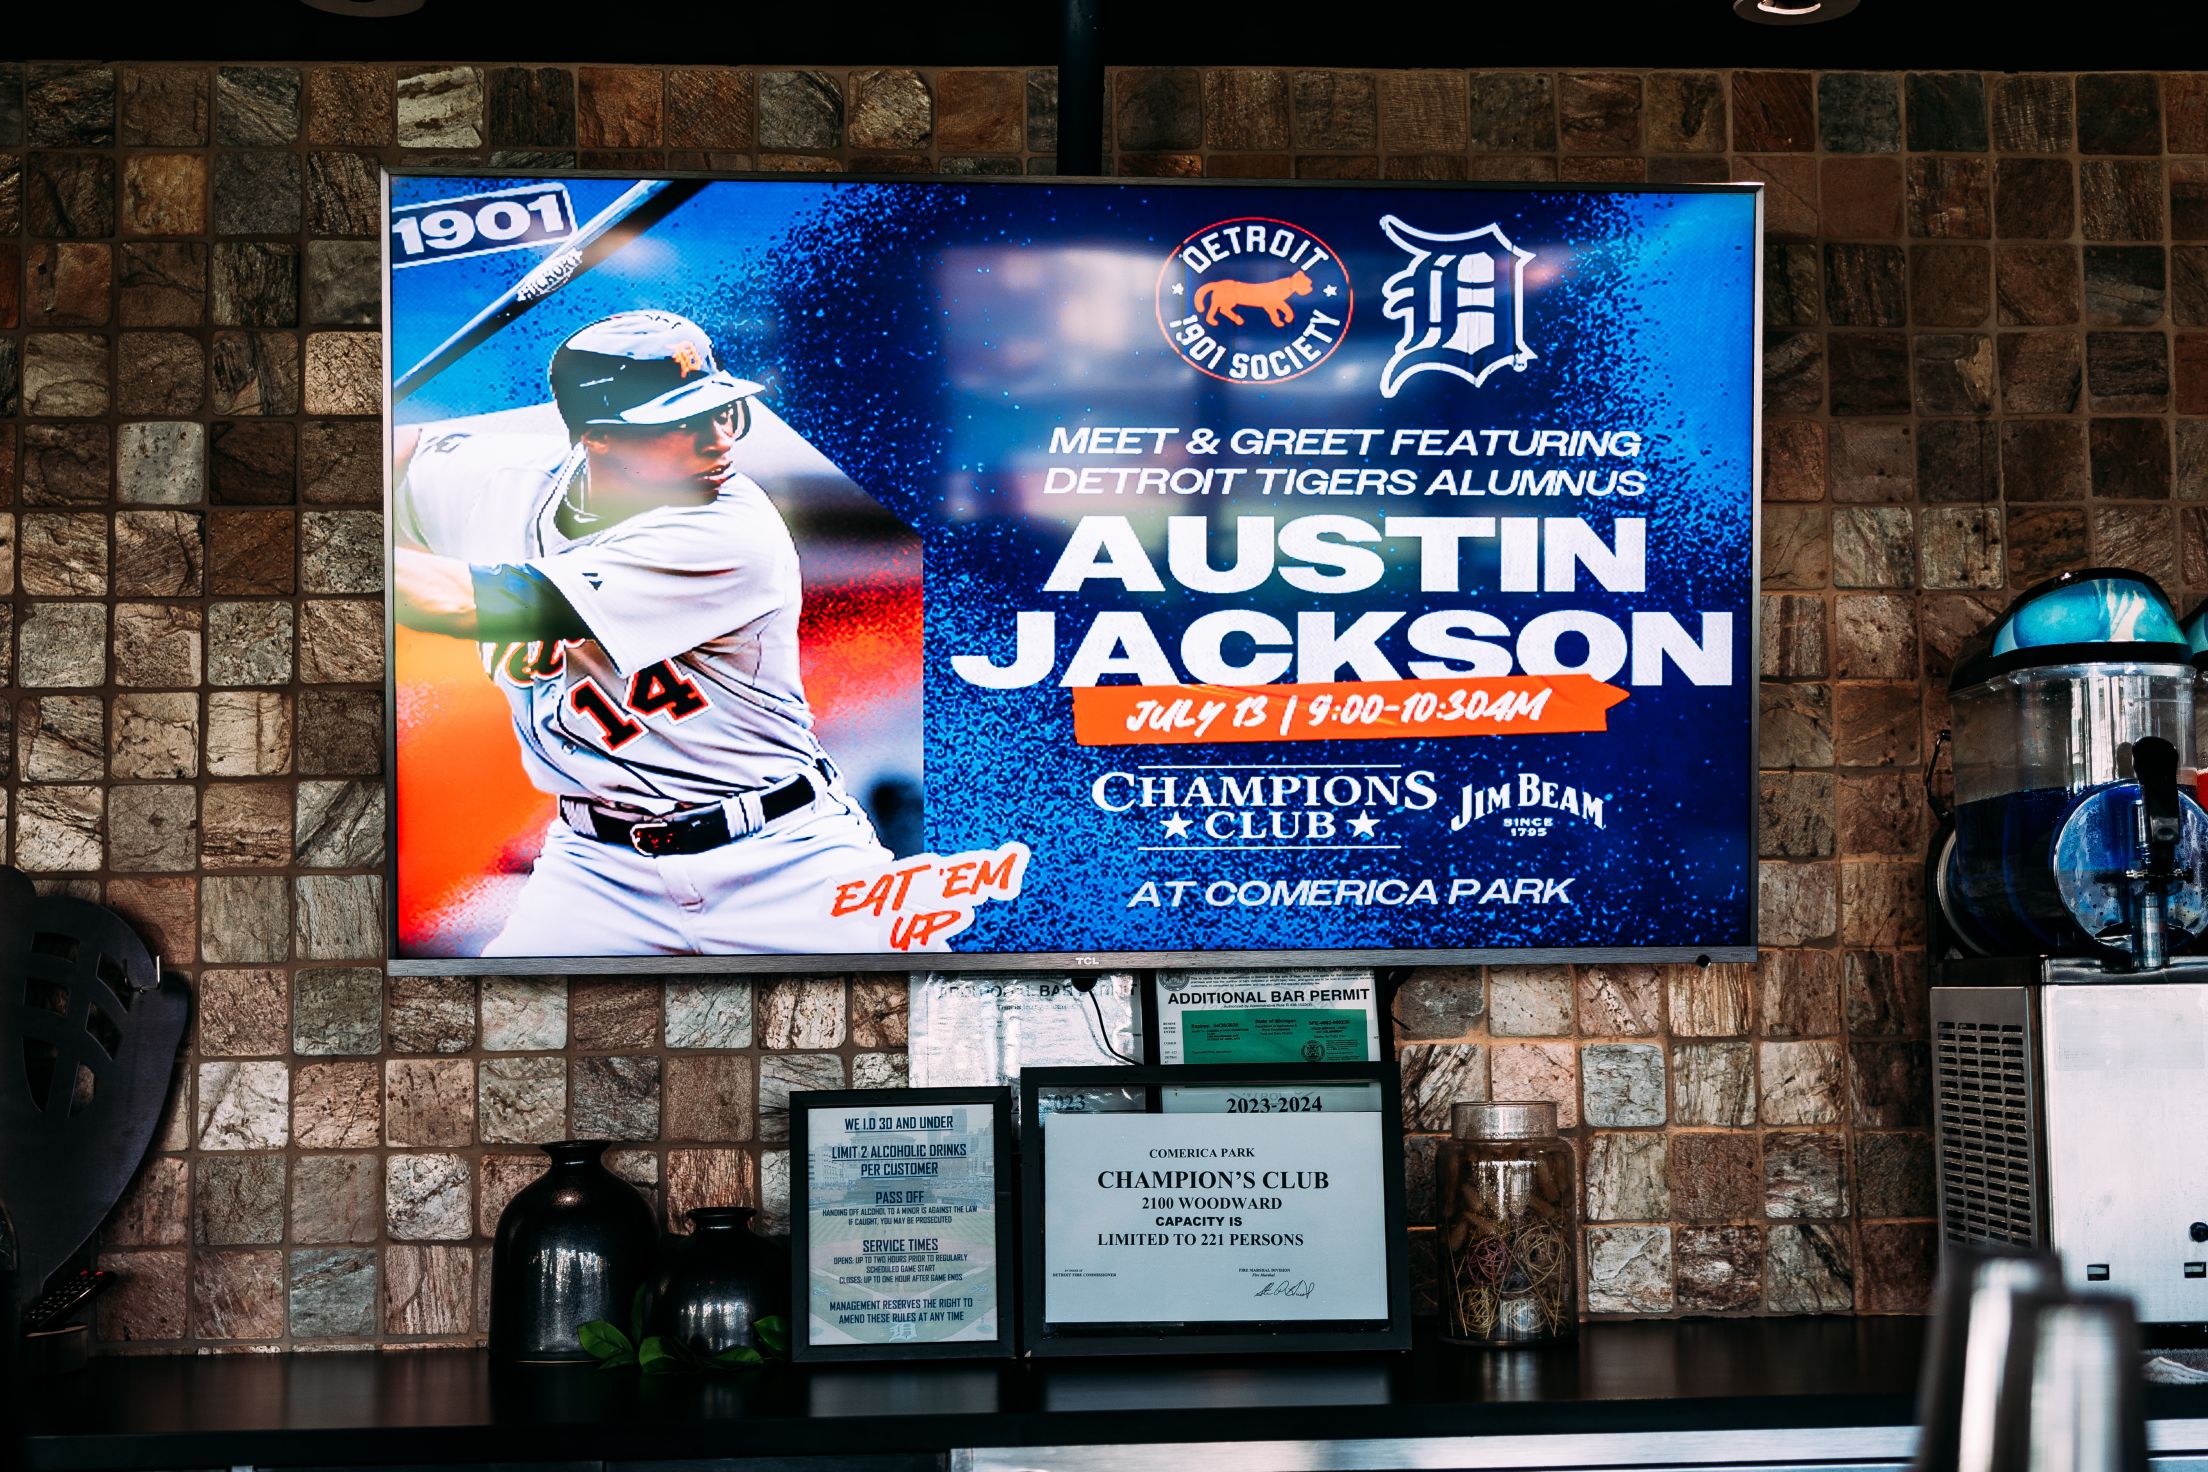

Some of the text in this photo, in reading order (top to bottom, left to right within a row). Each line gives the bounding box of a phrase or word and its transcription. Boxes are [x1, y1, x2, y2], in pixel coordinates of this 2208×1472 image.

[393, 194, 564, 254] 1901
[1183, 225, 1329, 274] DETROIT
[1169, 309, 1340, 381] 1901 SOCIETY
[1048, 427, 1641, 457] MEET & GREET FEATURING
[1043, 468, 1647, 497] DETROIT TIGERS ALUMNUS
[1042, 515, 1646, 594] AUSTIN
[951, 609, 1733, 688] JACKSON
[568, 658, 710, 751] 14
[1126, 698, 1230, 737] JULY
[1233, 694, 1265, 725] 13
[1308, 688, 1553, 726] 9:00-10:30AM
[1091, 771, 1437, 812] CHAMPIONS
[1450, 772, 1605, 832] JIM BEAM
[1204, 811, 1337, 839] CLUB
[1503, 817, 1553, 827] SINCE
[1509, 827, 1548, 837] 1795
[831, 853, 1018, 917] EAT 'EM
[1127, 877, 1576, 908] AT COMERICA PARK
[890, 910, 961, 951] UP
[1075, 957, 1099, 965] TCL
[1168, 989, 1370, 1004] ADDITIONAL BAR PERMIT
[1226, 1096, 1322, 1113] 2023-2024
[845, 1118, 860, 1131] WE
[879, 1118, 893, 1130] 30
[896, 1117, 917, 1129] AND
[920, 1116, 953, 1129] UNDER
[832, 1143, 967, 1159] LIMIT 2 ALCOHOLIC DRINKS
[1149, 1148, 1255, 1159] COMERICA PARK
[861, 1162, 938, 1176] PER CUSTOMER
[1097, 1171, 1329, 1189] CHAMPION'S CLUB
[876, 1191, 924, 1204] PASS OFF
[1141, 1197, 1282, 1210] 2100 WOODWARD
[861, 1208, 885, 1216] ALCOHOL
[902, 1207, 920, 1215] MINOR
[928, 1206, 952, 1214] AGAINST
[967, 1205, 977, 1213] LAW
[893, 1217, 905, 1225] MAY
[916, 1216, 952, 1224] PROSECUTED
[1156, 1217, 1242, 1227] CAPACITY IS
[863, 1238, 938, 1253] SERVICE TIMES
[1097, 1233, 1304, 1246] LIMITED TO 221 PERSONS
[908, 1255, 925, 1263] PRIOR
[935, 1254, 967, 1262] REGULARLY
[895, 1275, 910, 1283] HOUR
[931, 1274, 946, 1282] GAME
[830, 1298, 973, 1311] MANAGEMENT RESERVES THE RIGHT TO
[839, 1311, 964, 1324] AMEND THESE RULES AT ANY TIME
